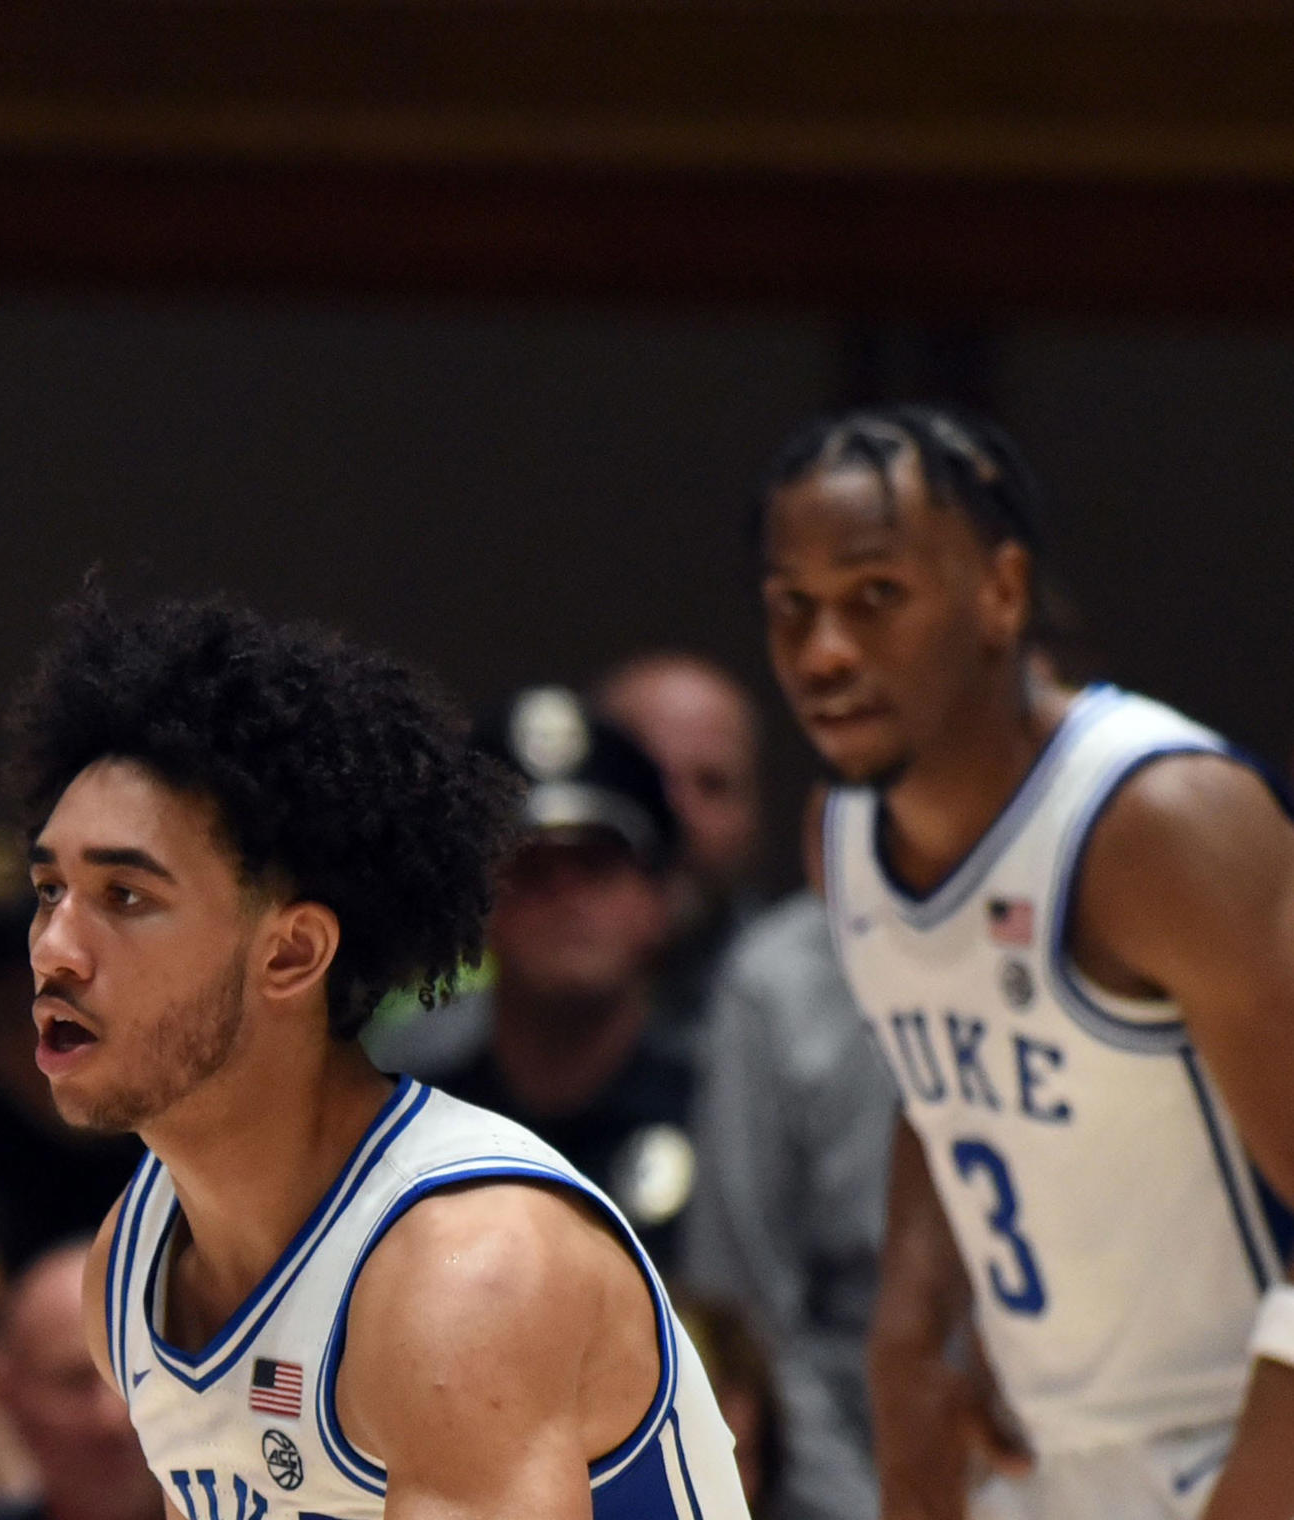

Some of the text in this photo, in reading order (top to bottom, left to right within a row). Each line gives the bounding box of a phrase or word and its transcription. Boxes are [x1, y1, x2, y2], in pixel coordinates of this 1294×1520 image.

[890, 1008, 1072, 1124] UKE
[952, 1136, 1048, 1318] 3
[268, 1448, 299, 1470] ACC
